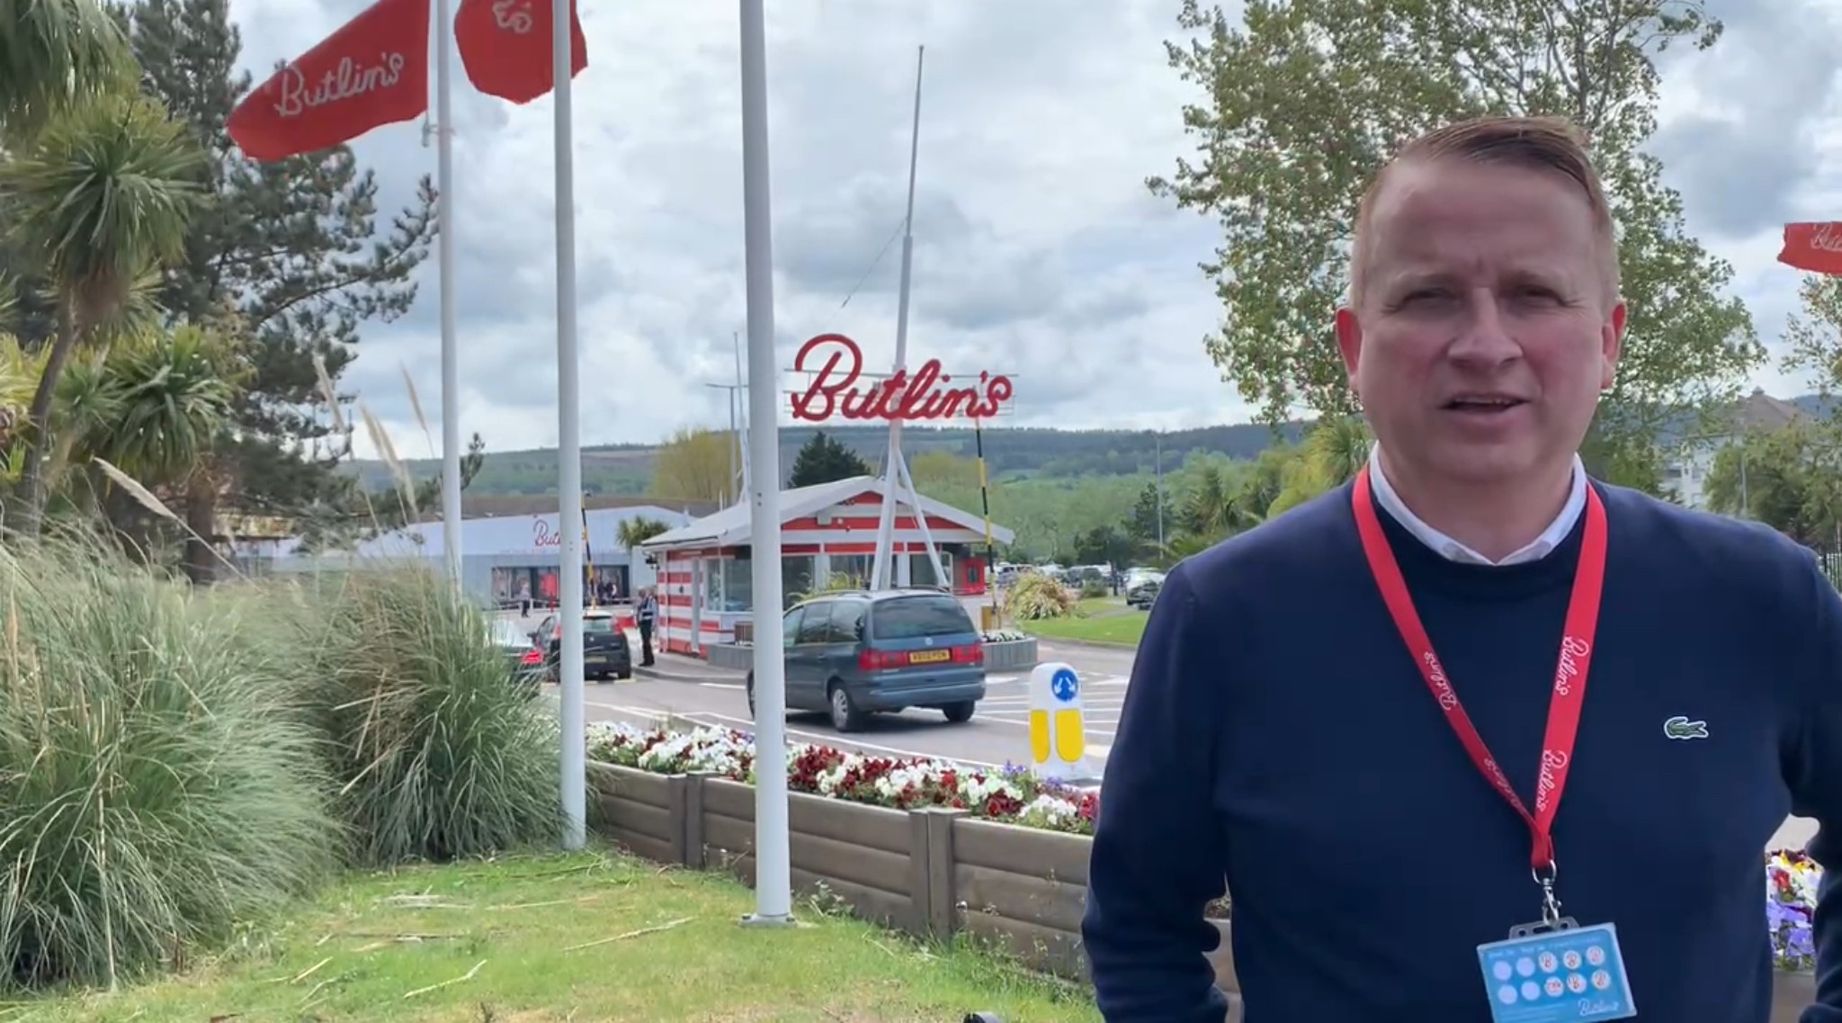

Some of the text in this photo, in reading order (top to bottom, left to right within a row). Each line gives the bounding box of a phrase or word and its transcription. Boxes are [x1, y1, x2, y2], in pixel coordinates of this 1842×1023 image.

[266, 52, 404, 116] Butlin's
[791, 333, 1012, 421] Butlin's
[533, 519, 561, 547] But
[1424, 651, 1457, 710] Butlin's
[1555, 636, 1590, 696] Butlin's
[1536, 749, 1568, 812] Butlin's
